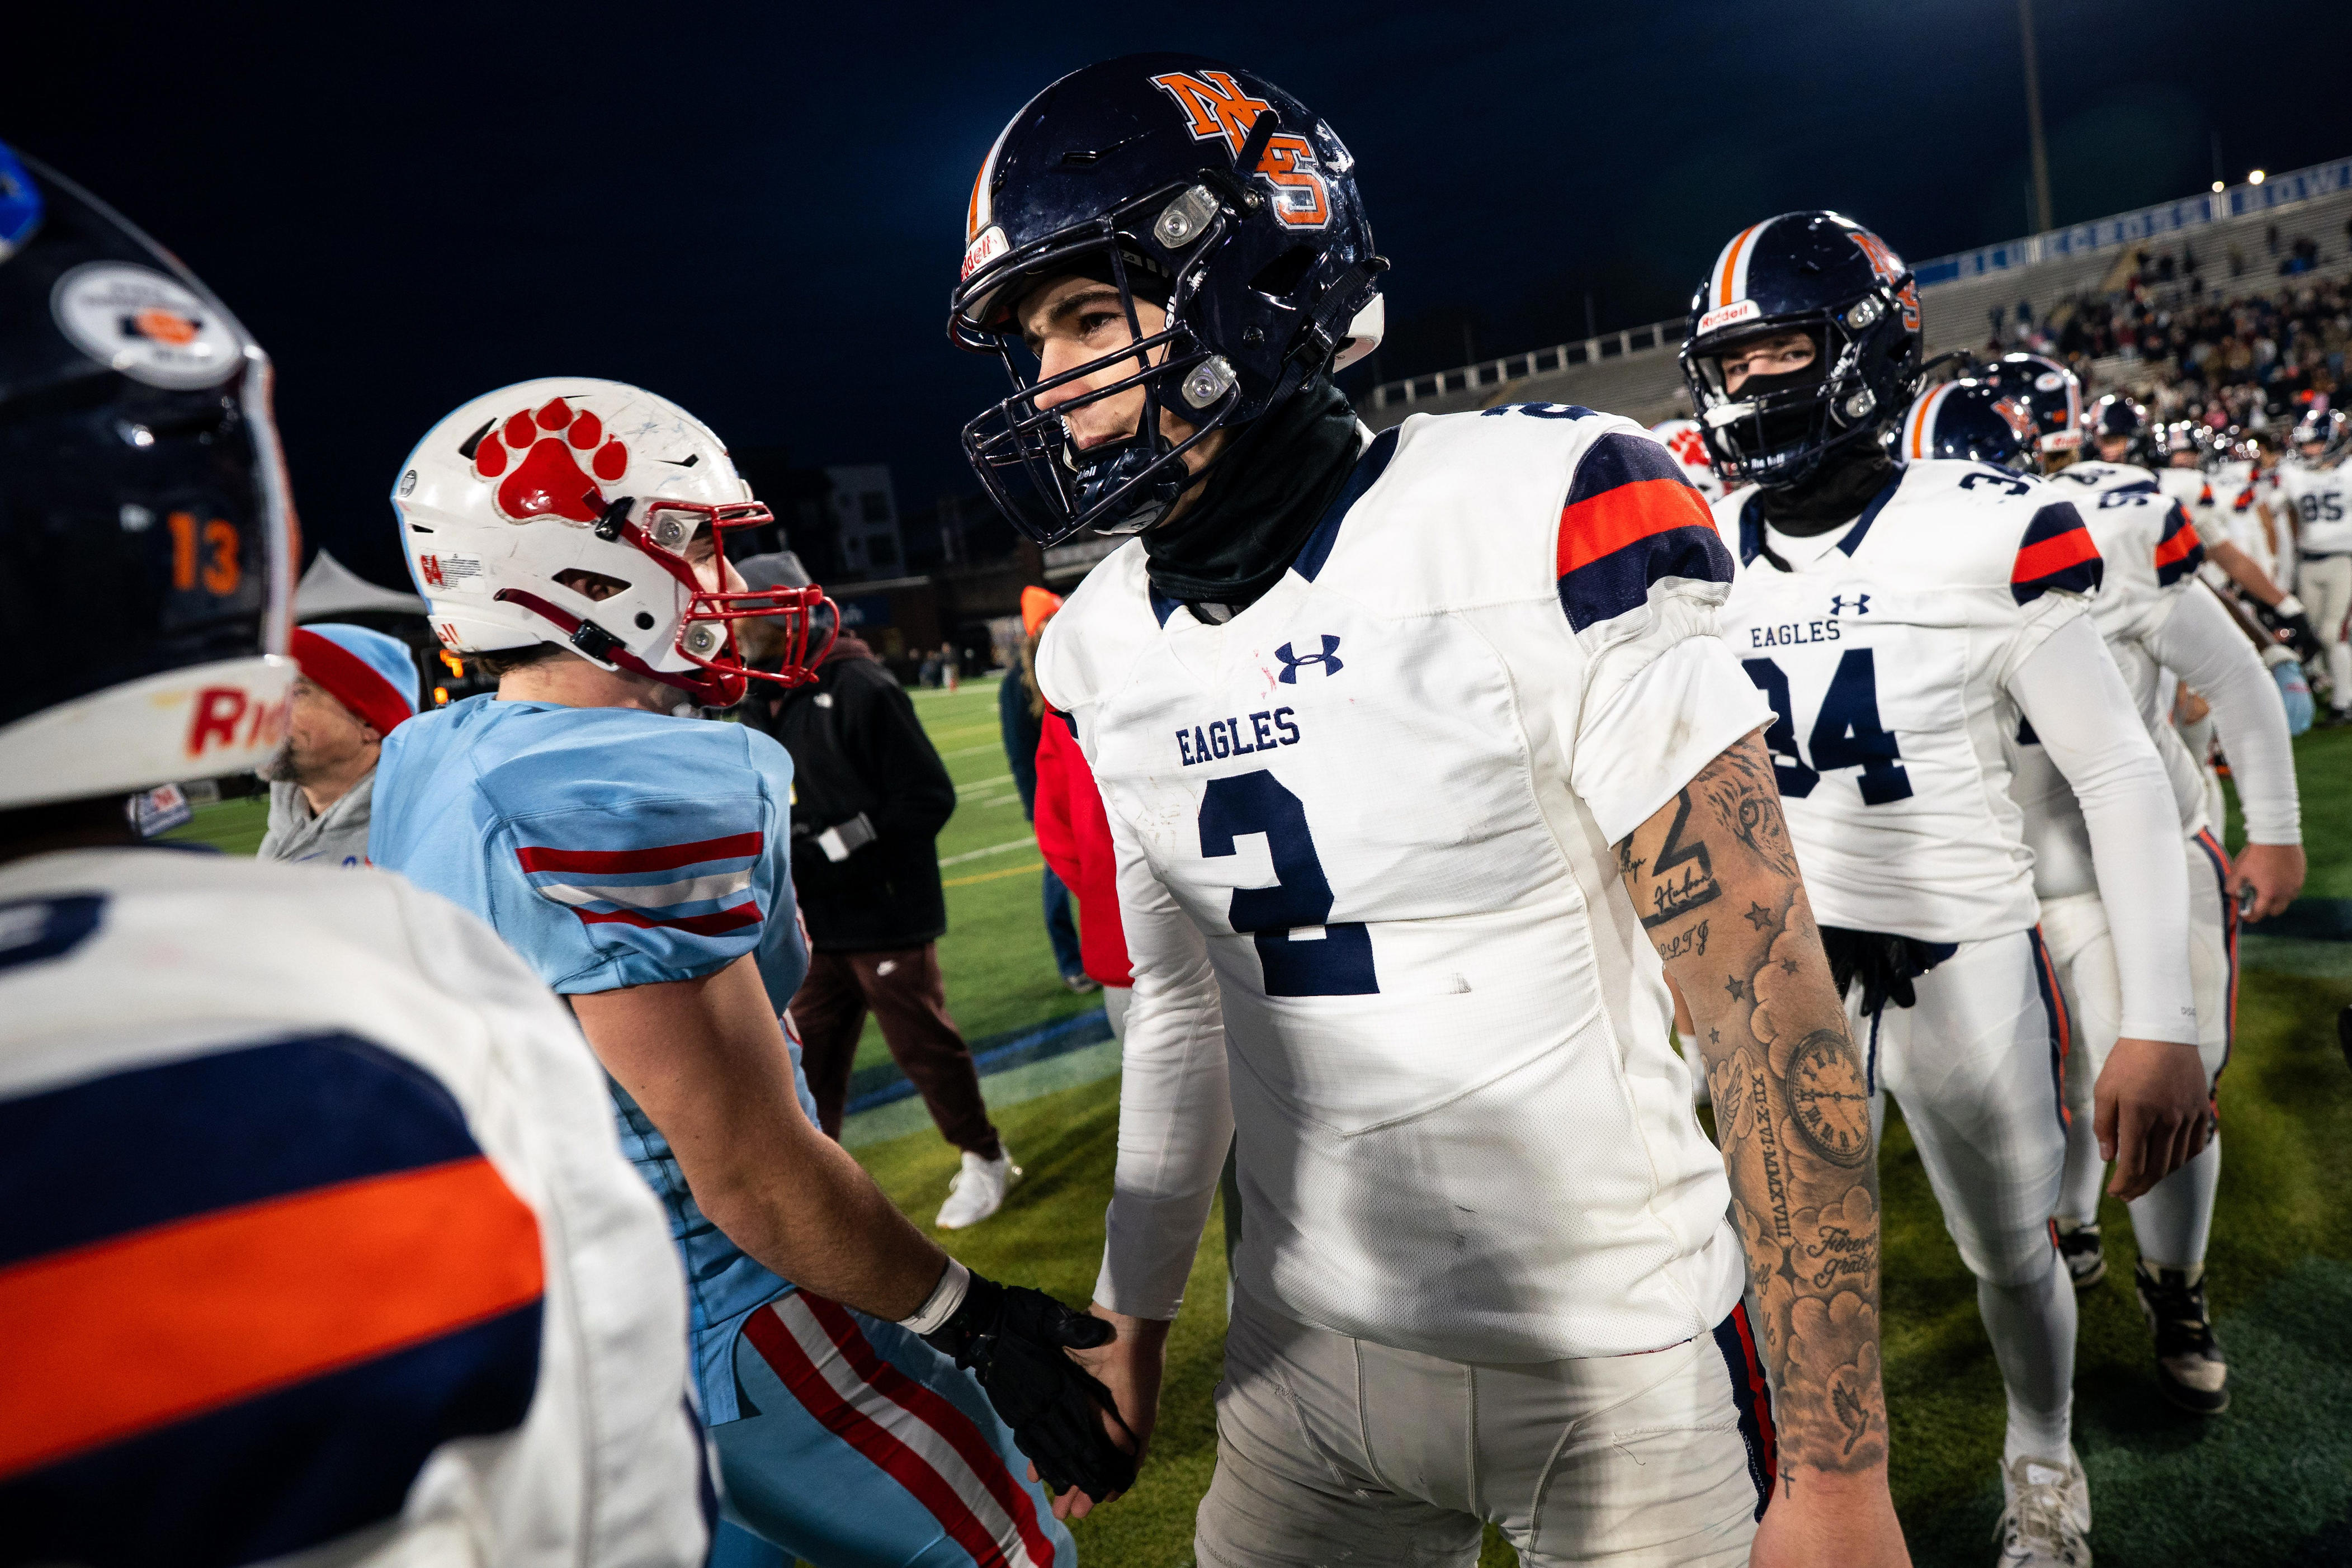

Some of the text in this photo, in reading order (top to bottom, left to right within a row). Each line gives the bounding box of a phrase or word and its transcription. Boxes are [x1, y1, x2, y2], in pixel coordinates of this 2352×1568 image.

[169, 511, 243, 597] 13
[1750, 619, 1841, 648] EAGLES
[1176, 706, 1301, 766] EAGLES
[1198, 769, 1381, 996] 2
